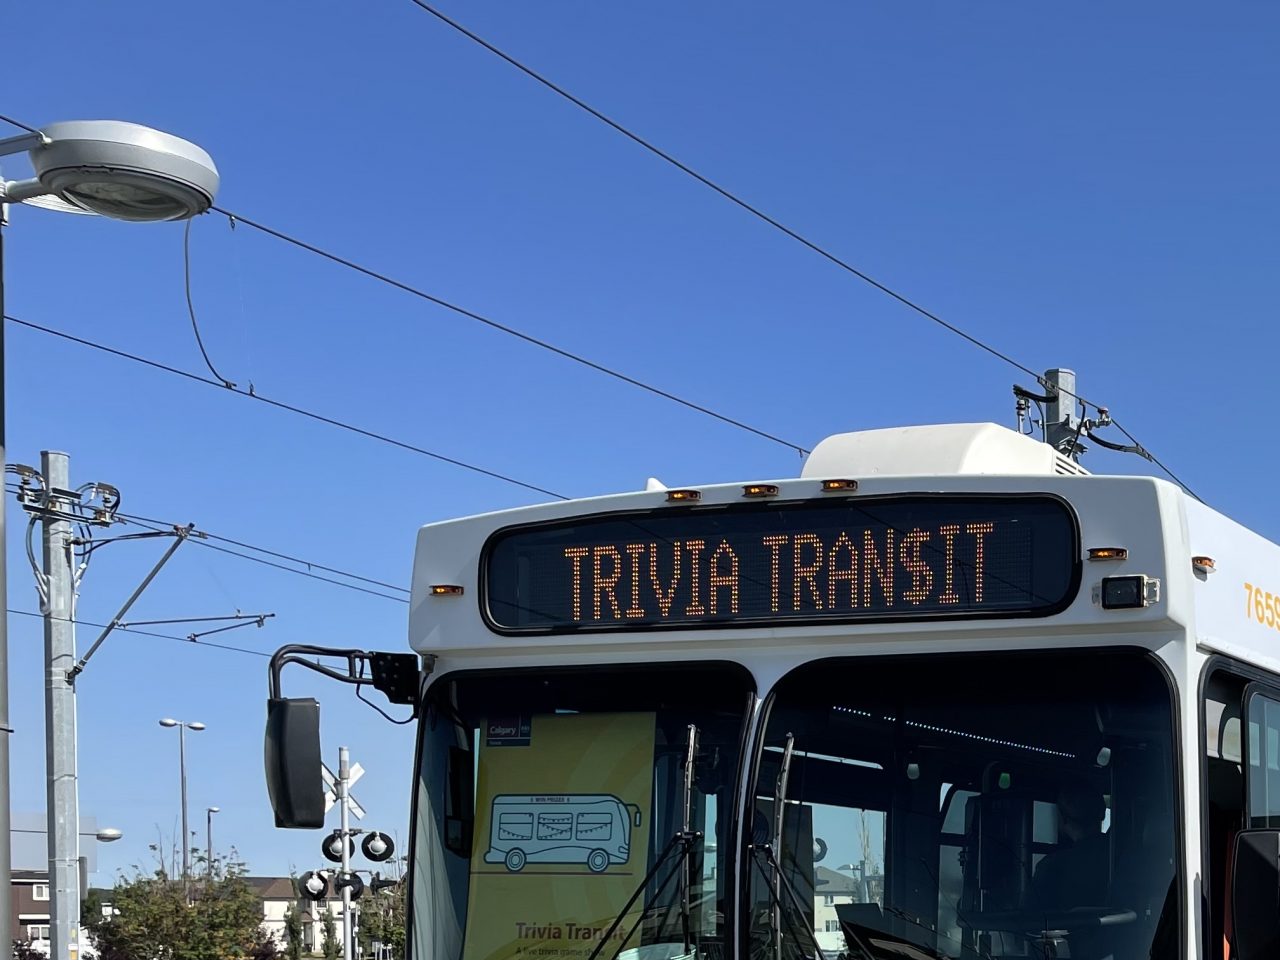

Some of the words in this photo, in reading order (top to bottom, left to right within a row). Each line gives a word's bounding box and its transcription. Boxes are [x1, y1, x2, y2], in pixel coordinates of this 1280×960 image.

[563, 538, 739, 621] TRIVIA
[762, 521, 995, 612] TRANSIT
[490, 726, 517, 736] Calgary
[515, 922, 562, 940] Trivia
[565, 922, 626, 940] Tranit
